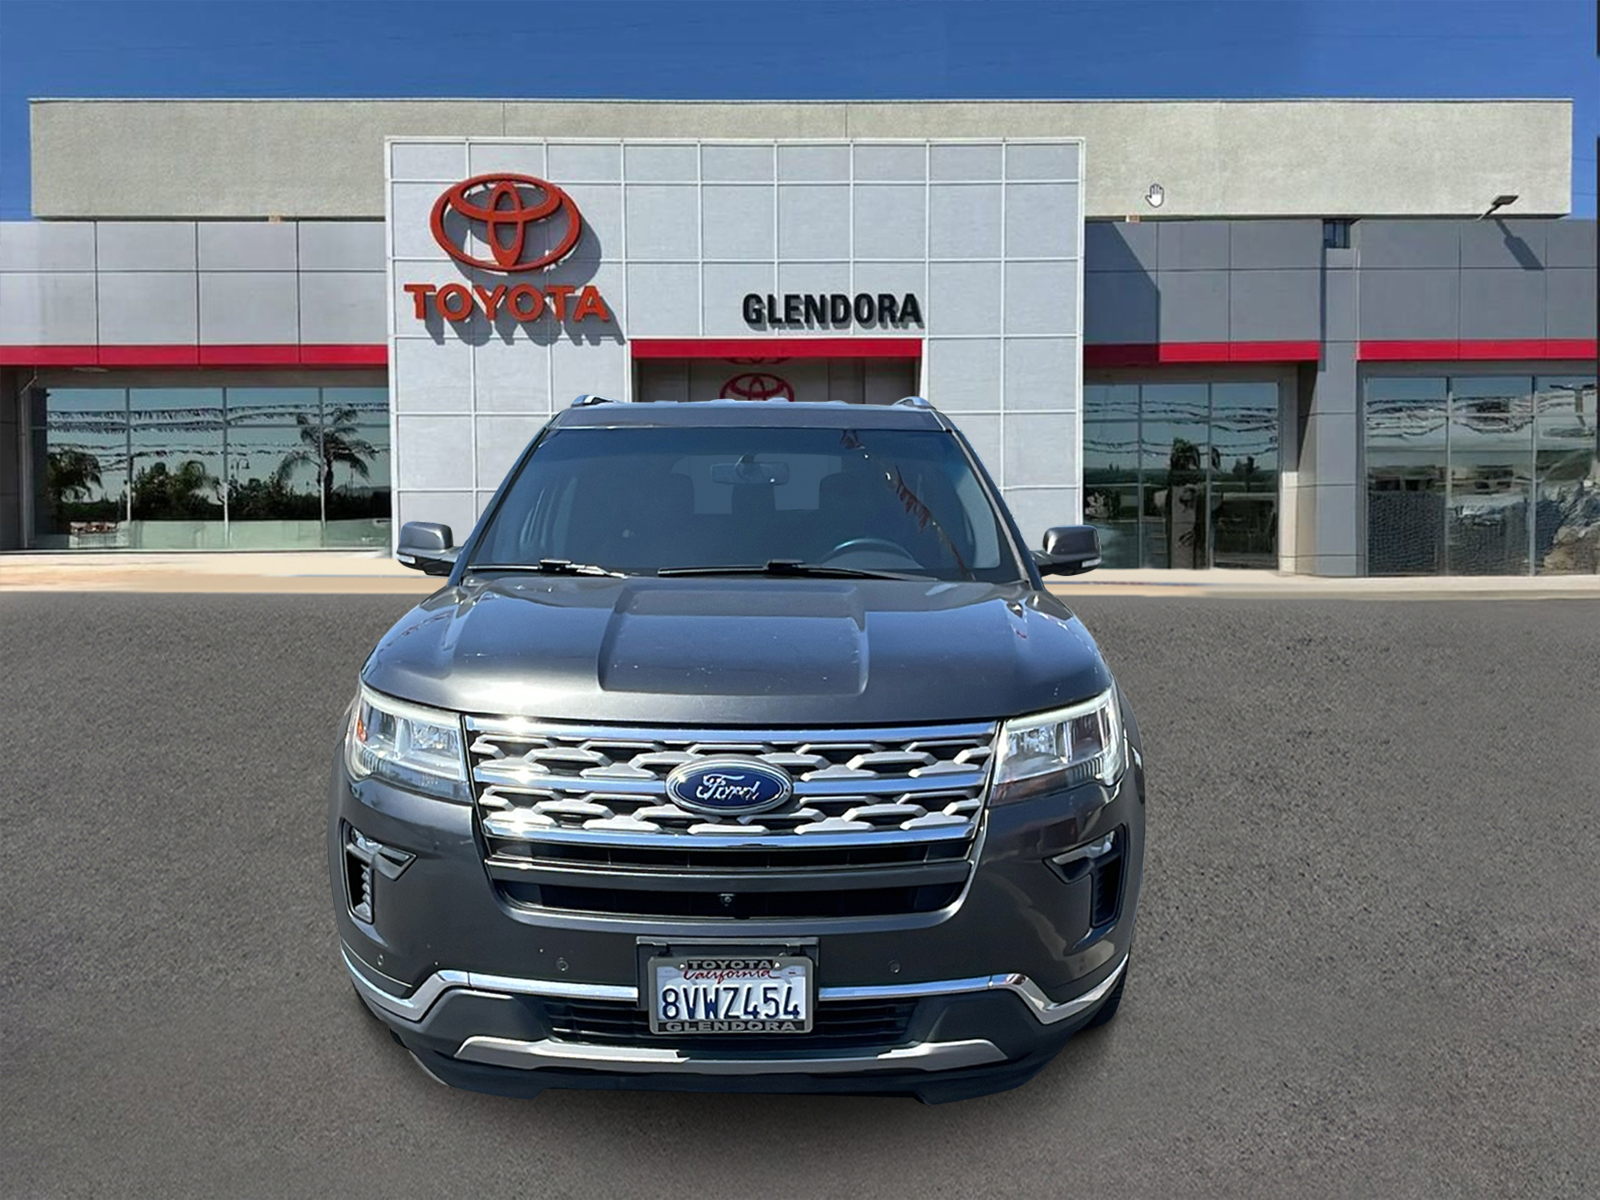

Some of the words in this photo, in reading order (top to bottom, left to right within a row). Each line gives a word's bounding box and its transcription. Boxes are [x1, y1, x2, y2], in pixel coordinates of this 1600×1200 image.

[403, 283, 611, 323] TOYOTA
[742, 293, 923, 326] GLENDORA
[696, 773, 761, 800] Ford
[683, 969, 781, 984] California
[688, 960, 773, 969] TOYOTA
[662, 986, 800, 1020] 8VWZ454
[665, 1021, 797, 1031] GLENDORA
